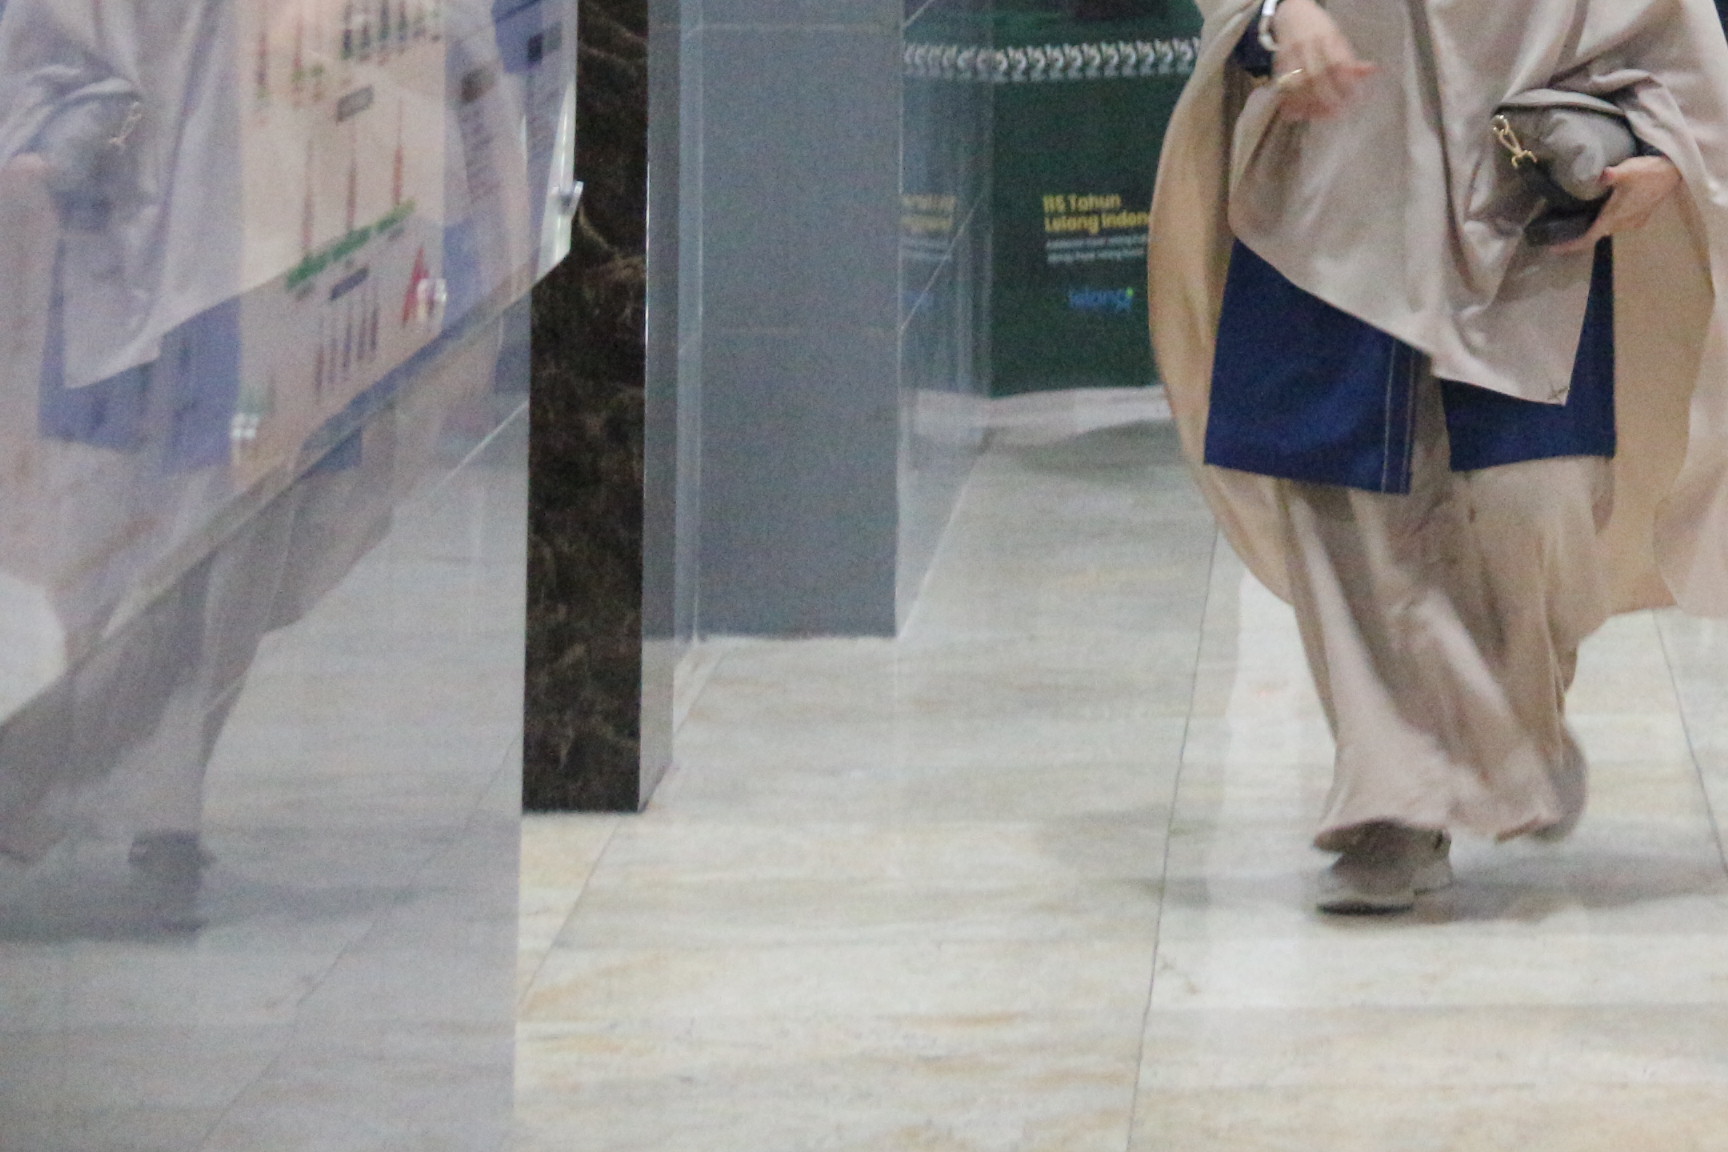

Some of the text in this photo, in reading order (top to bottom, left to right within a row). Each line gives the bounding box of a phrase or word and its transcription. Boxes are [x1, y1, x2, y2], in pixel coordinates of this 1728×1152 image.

[1068, 194, 1121, 210] Tahun
[1045, 211, 1151, 234] Lelang Indon
